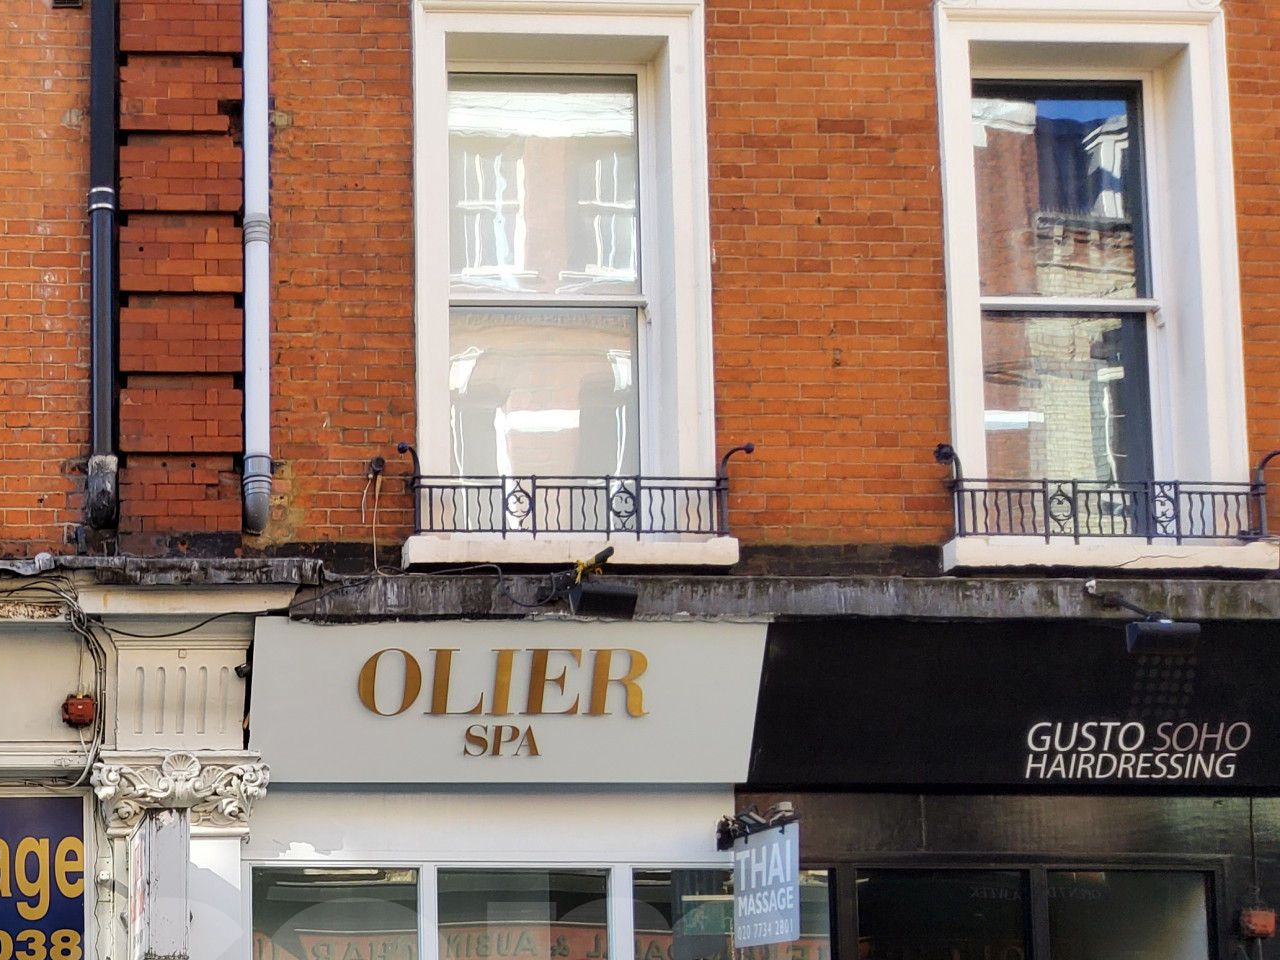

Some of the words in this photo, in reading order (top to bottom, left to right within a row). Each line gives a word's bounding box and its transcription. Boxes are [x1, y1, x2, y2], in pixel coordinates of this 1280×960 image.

[357, 647, 650, 718] OLIER
[463, 724, 542, 757] SPA
[1027, 722, 1145, 752] GUSTO
[1152, 722, 1252, 751] SOHO
[1025, 753, 1238, 779] HAIRDRESSING
[735, 839, 791, 891] THAI
[737, 886, 794, 918] MASSAGE
[737, 925, 751, 941] 020
